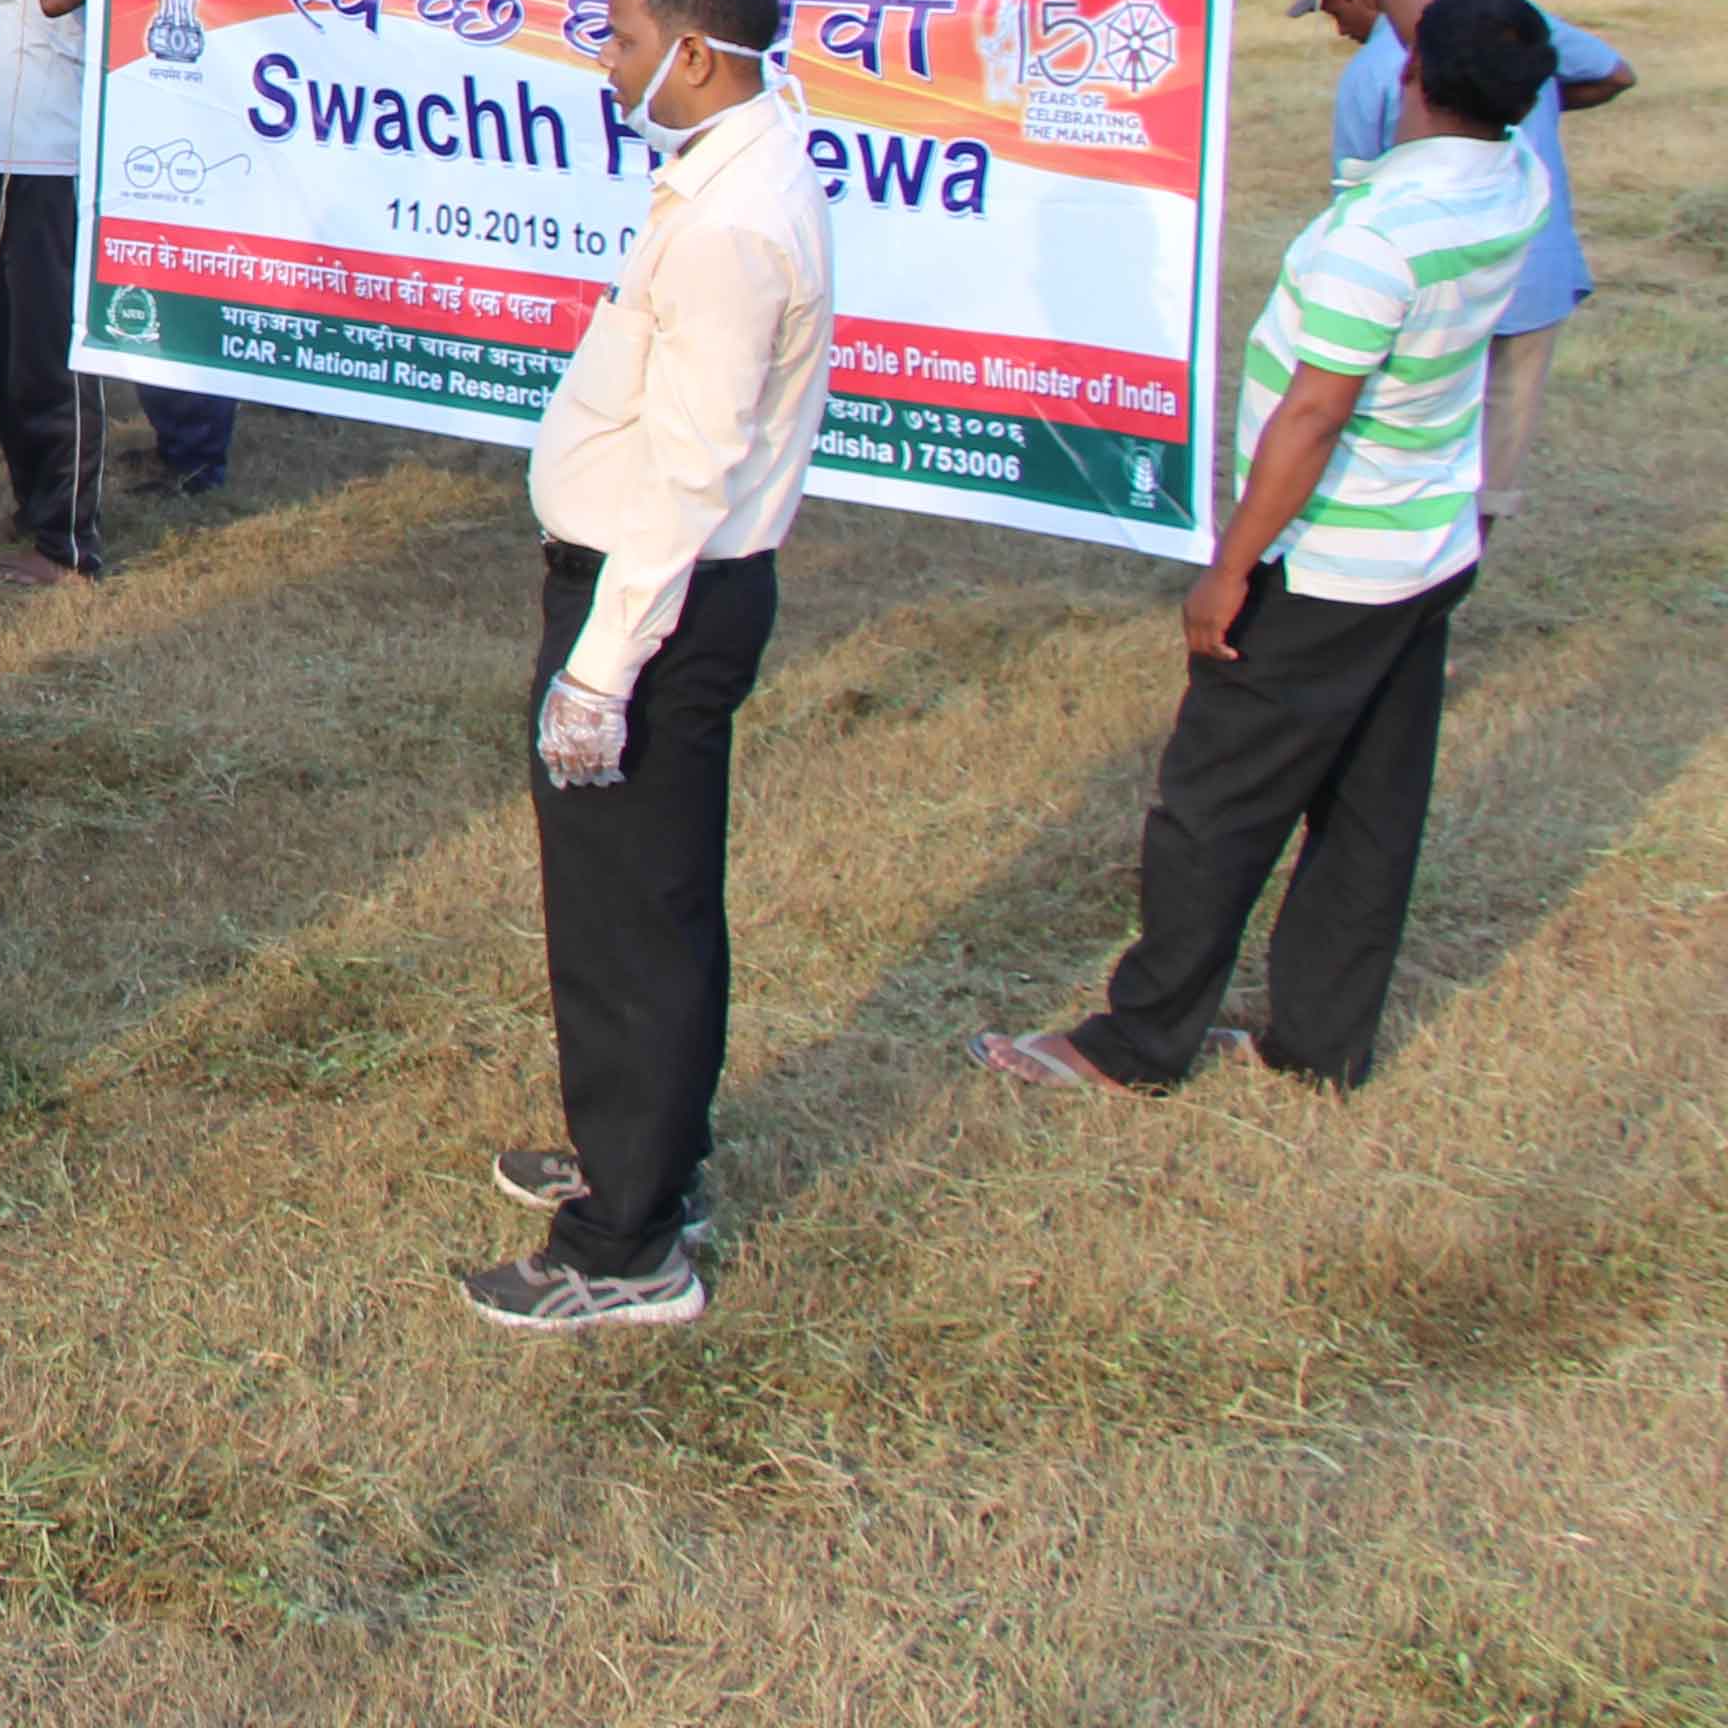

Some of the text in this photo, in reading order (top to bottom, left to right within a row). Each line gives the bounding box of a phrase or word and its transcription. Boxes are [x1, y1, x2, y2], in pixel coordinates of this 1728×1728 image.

[247, 52, 571, 172] Swachh
[1025, 107, 1140, 129] CELEBRATING
[1029, 91, 1105, 108] YEARS OF
[1025, 124, 1147, 146] THE MAHATMA
[387, 199, 560, 250] 11.09.2019
[573, 222, 607, 256] to
[104, 236, 155, 268] भारत
[157, 235, 177, 270] के
[181, 244, 258, 282] माननीय
[397, 271, 428, 307] की
[469, 287, 504, 318] एक
[506, 292, 556, 325] पहल
[419, 335, 484, 364] चावल
[827, 340, 1177, 417] on'ble Prime Minister of India
[221, 334, 277, 365] ICAR
[295, 346, 388, 383] National
[394, 363, 443, 391] Rice
[918, 442, 1021, 482] 753006
